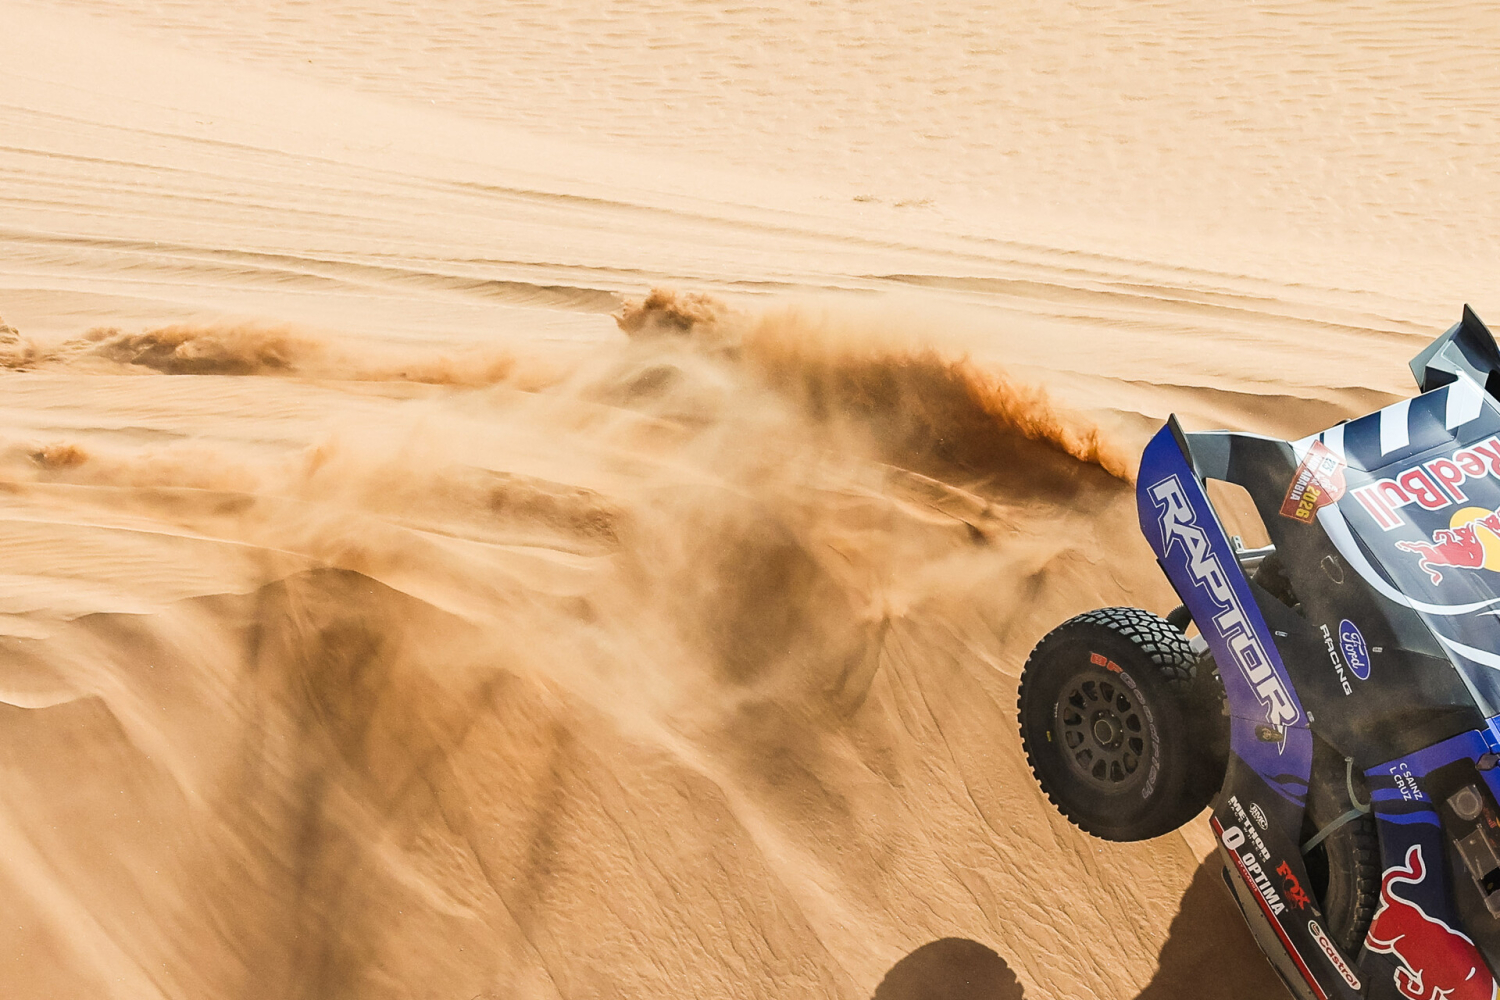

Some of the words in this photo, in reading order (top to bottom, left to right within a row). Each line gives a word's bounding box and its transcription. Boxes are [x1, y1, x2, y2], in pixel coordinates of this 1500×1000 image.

[1296, 485, 1321, 518] 2026
[1147, 473, 1299, 756] RAPTOR
[1320, 624, 1352, 696] RACING
[1342, 632, 1365, 669] Ford
[1389, 766, 1397, 774] L
[1394, 774, 1412, 801] CRUZ
[1403, 771, 1423, 800] SAINZ
[1229, 795, 1271, 861] METHOD
[1276, 860, 1310, 910] FOX
[1320, 936, 1357, 987] Castrol
